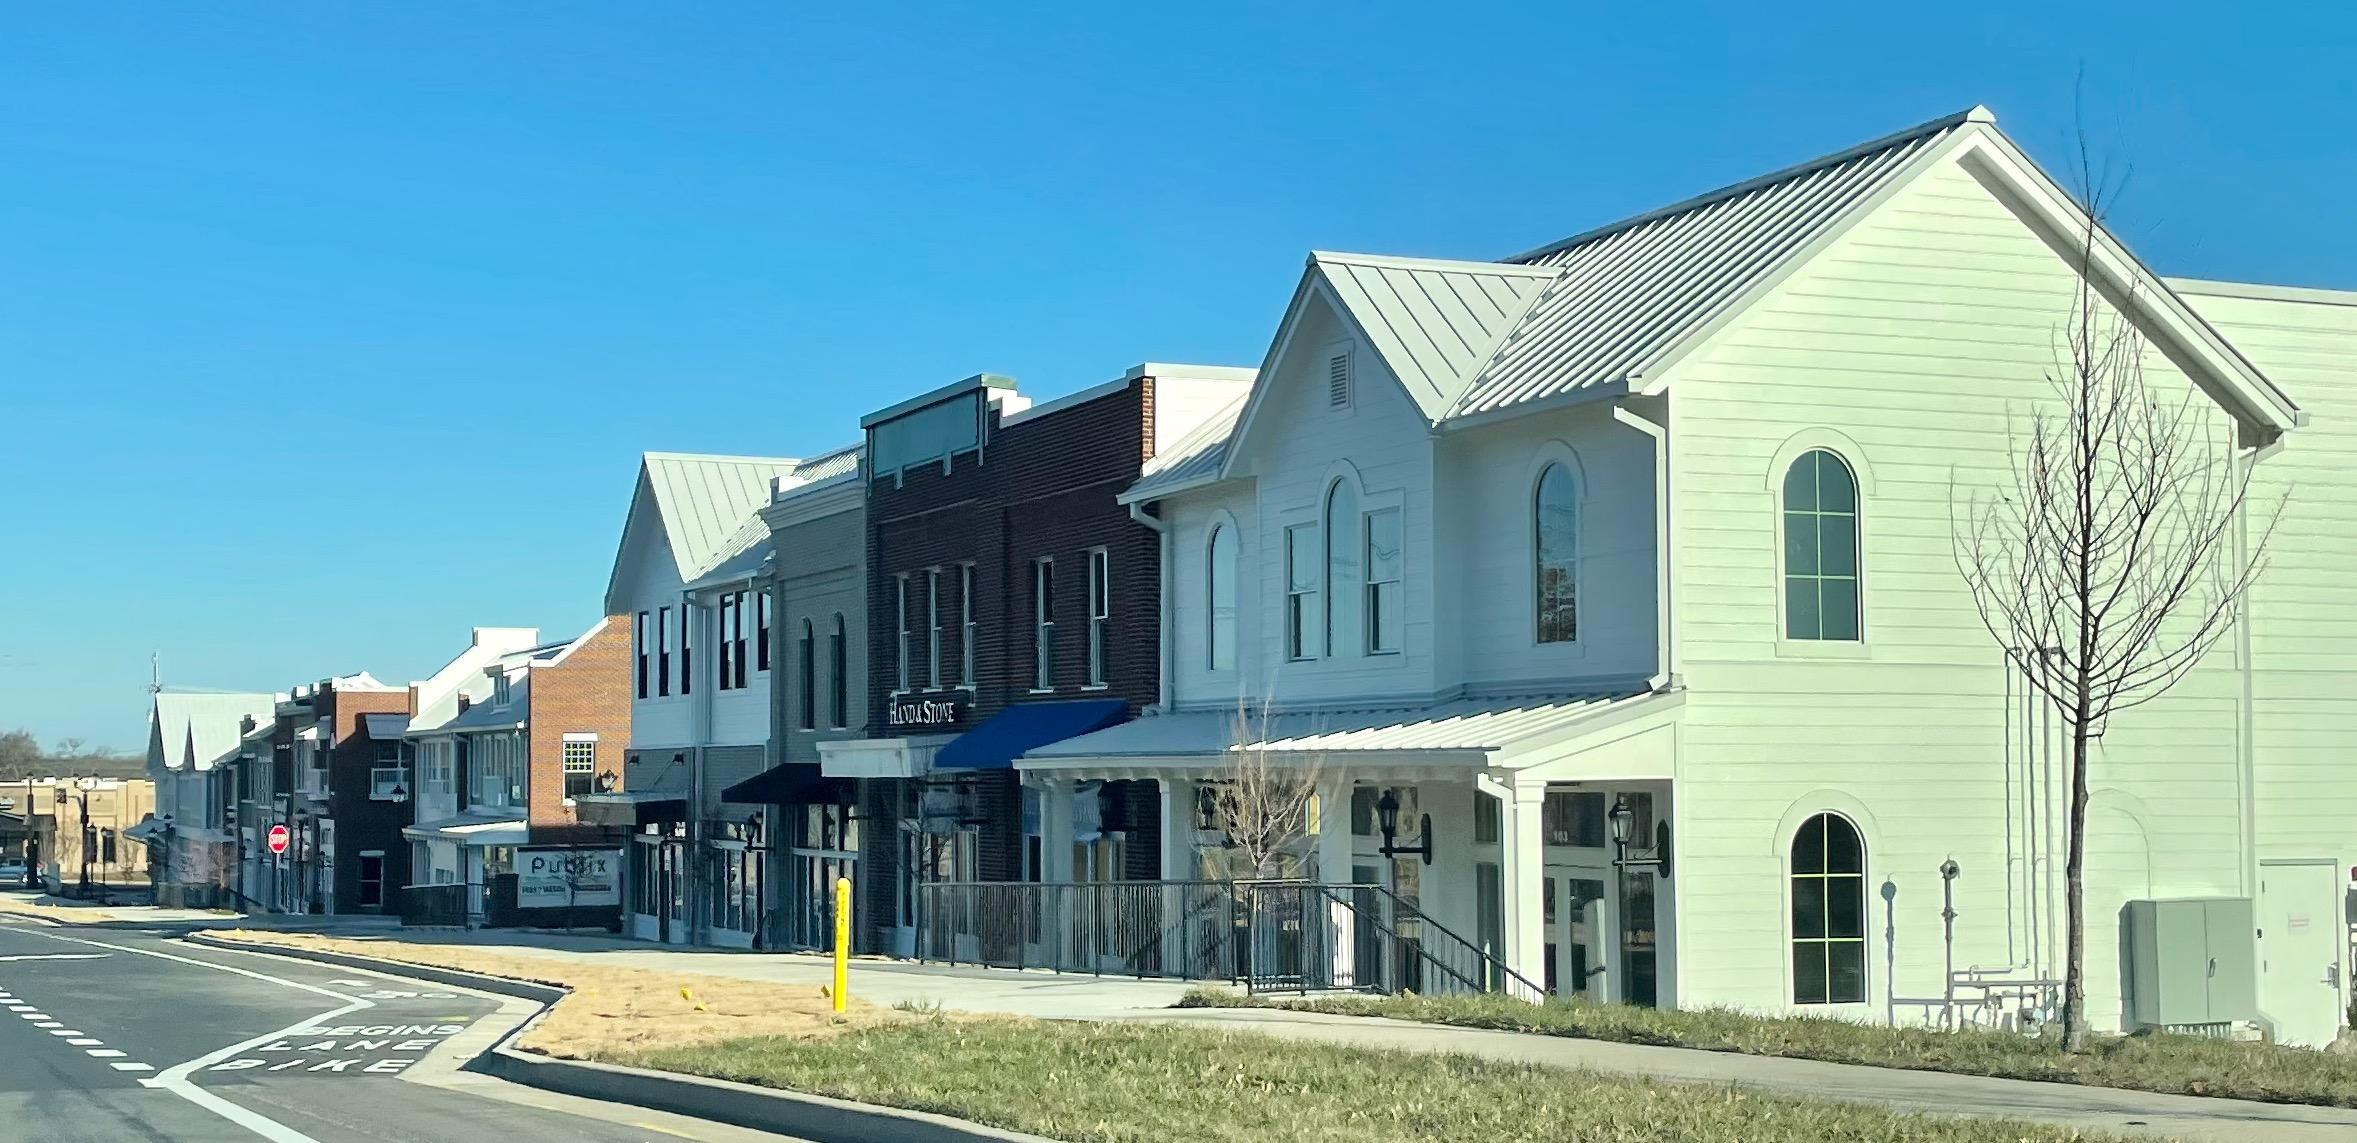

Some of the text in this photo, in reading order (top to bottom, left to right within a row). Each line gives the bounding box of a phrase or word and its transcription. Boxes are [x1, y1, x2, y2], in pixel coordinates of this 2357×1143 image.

[270, 833, 288, 845] STOP
[288, 1024, 466, 1036] BEGINS
[258, 1038, 440, 1051] LANE
[208, 1057, 415, 1073] BIKE
